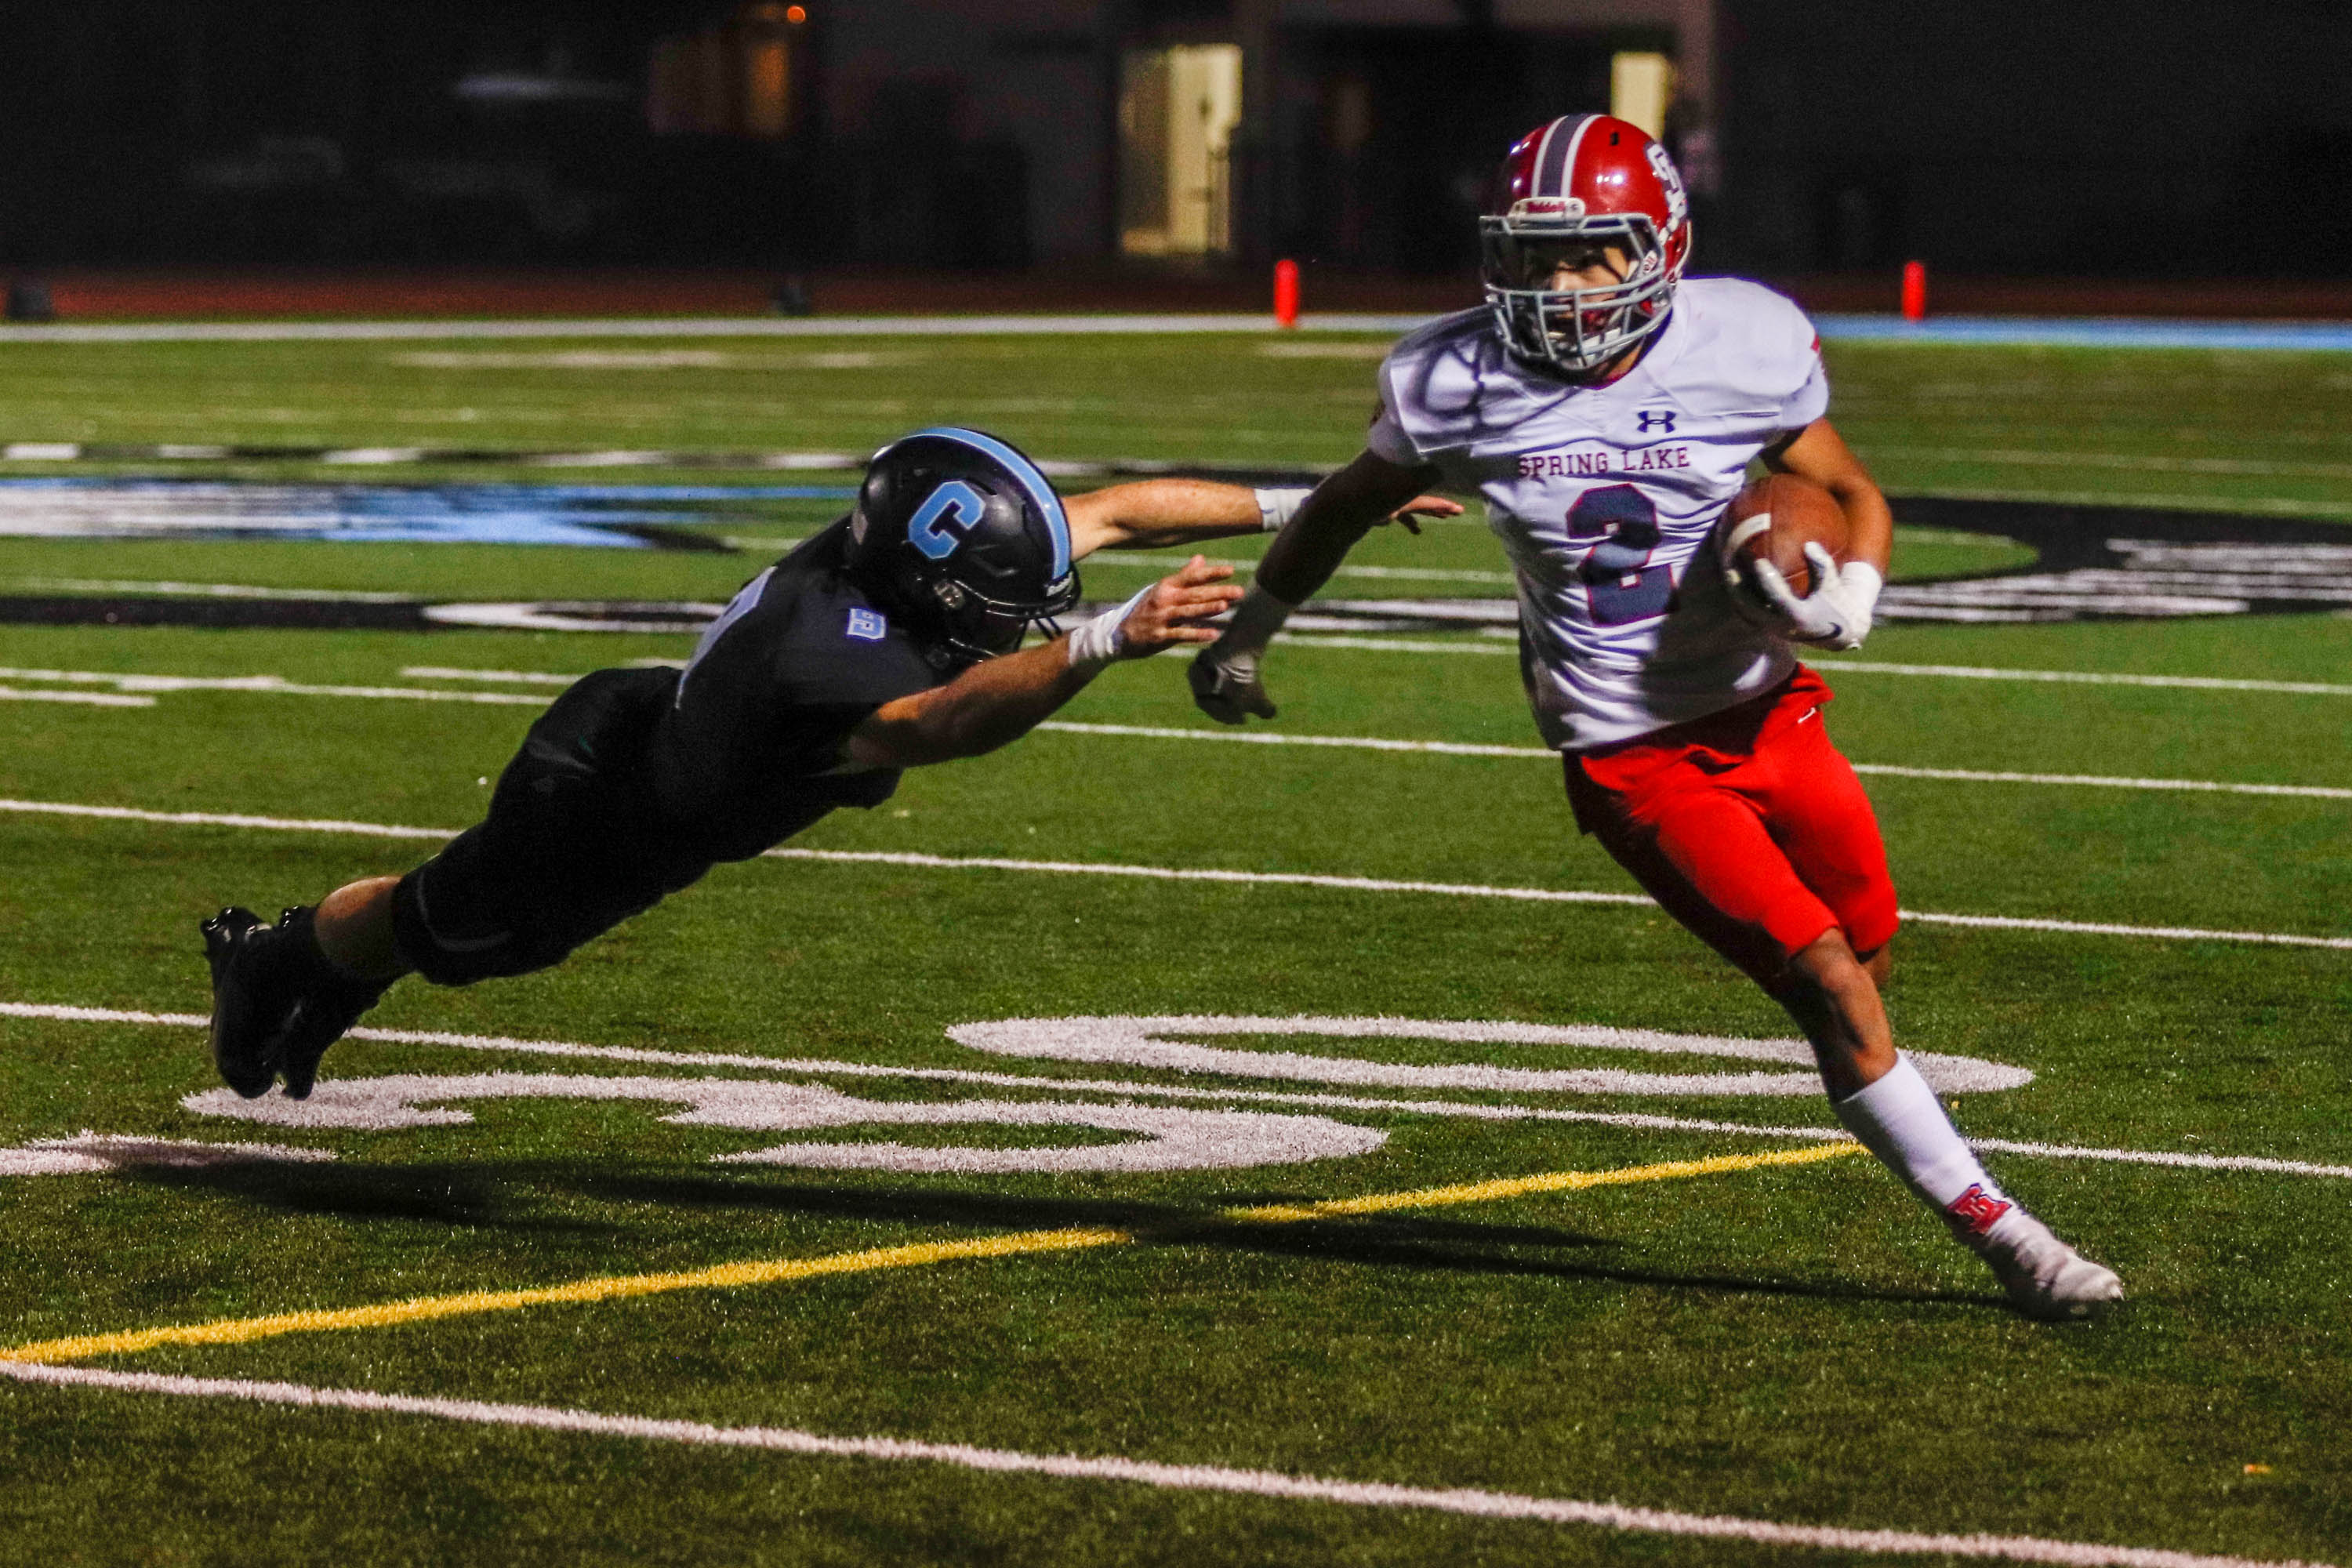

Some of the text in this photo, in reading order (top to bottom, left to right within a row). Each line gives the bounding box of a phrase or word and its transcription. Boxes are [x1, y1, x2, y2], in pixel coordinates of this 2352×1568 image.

[1519, 446, 1690, 477] SPRING LAKE
[908, 480, 985, 560] C
[1566, 481, 1679, 628] 2
